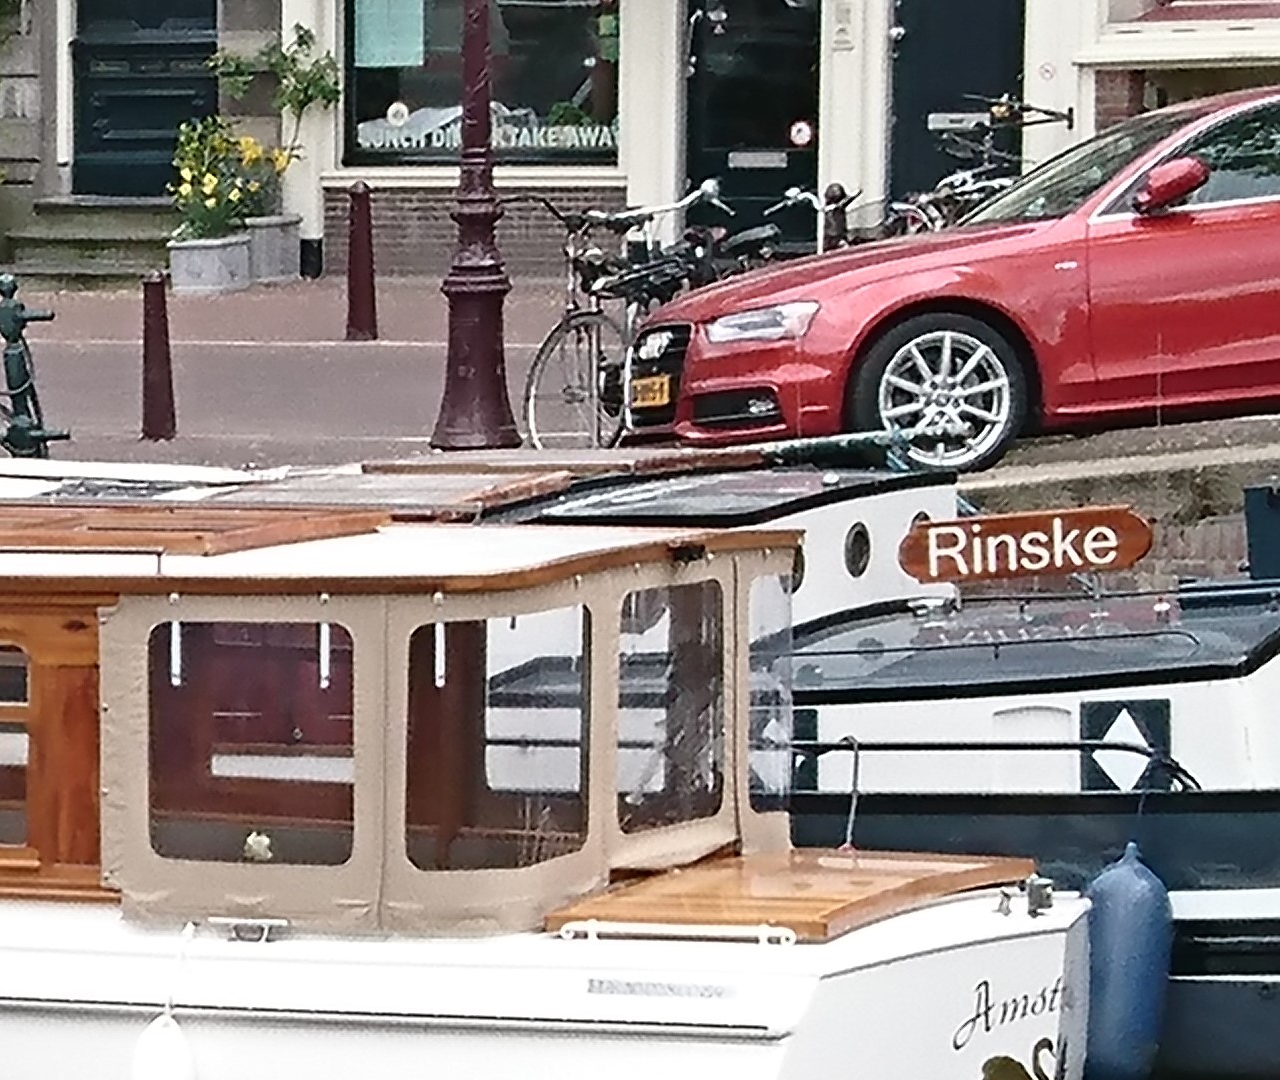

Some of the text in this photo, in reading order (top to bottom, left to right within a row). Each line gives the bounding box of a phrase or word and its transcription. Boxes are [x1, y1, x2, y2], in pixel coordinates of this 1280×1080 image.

[506, 125, 558, 148] TAKE
[926, 516, 1119, 577] Rinske
[952, 975, 1074, 1051] Amst
